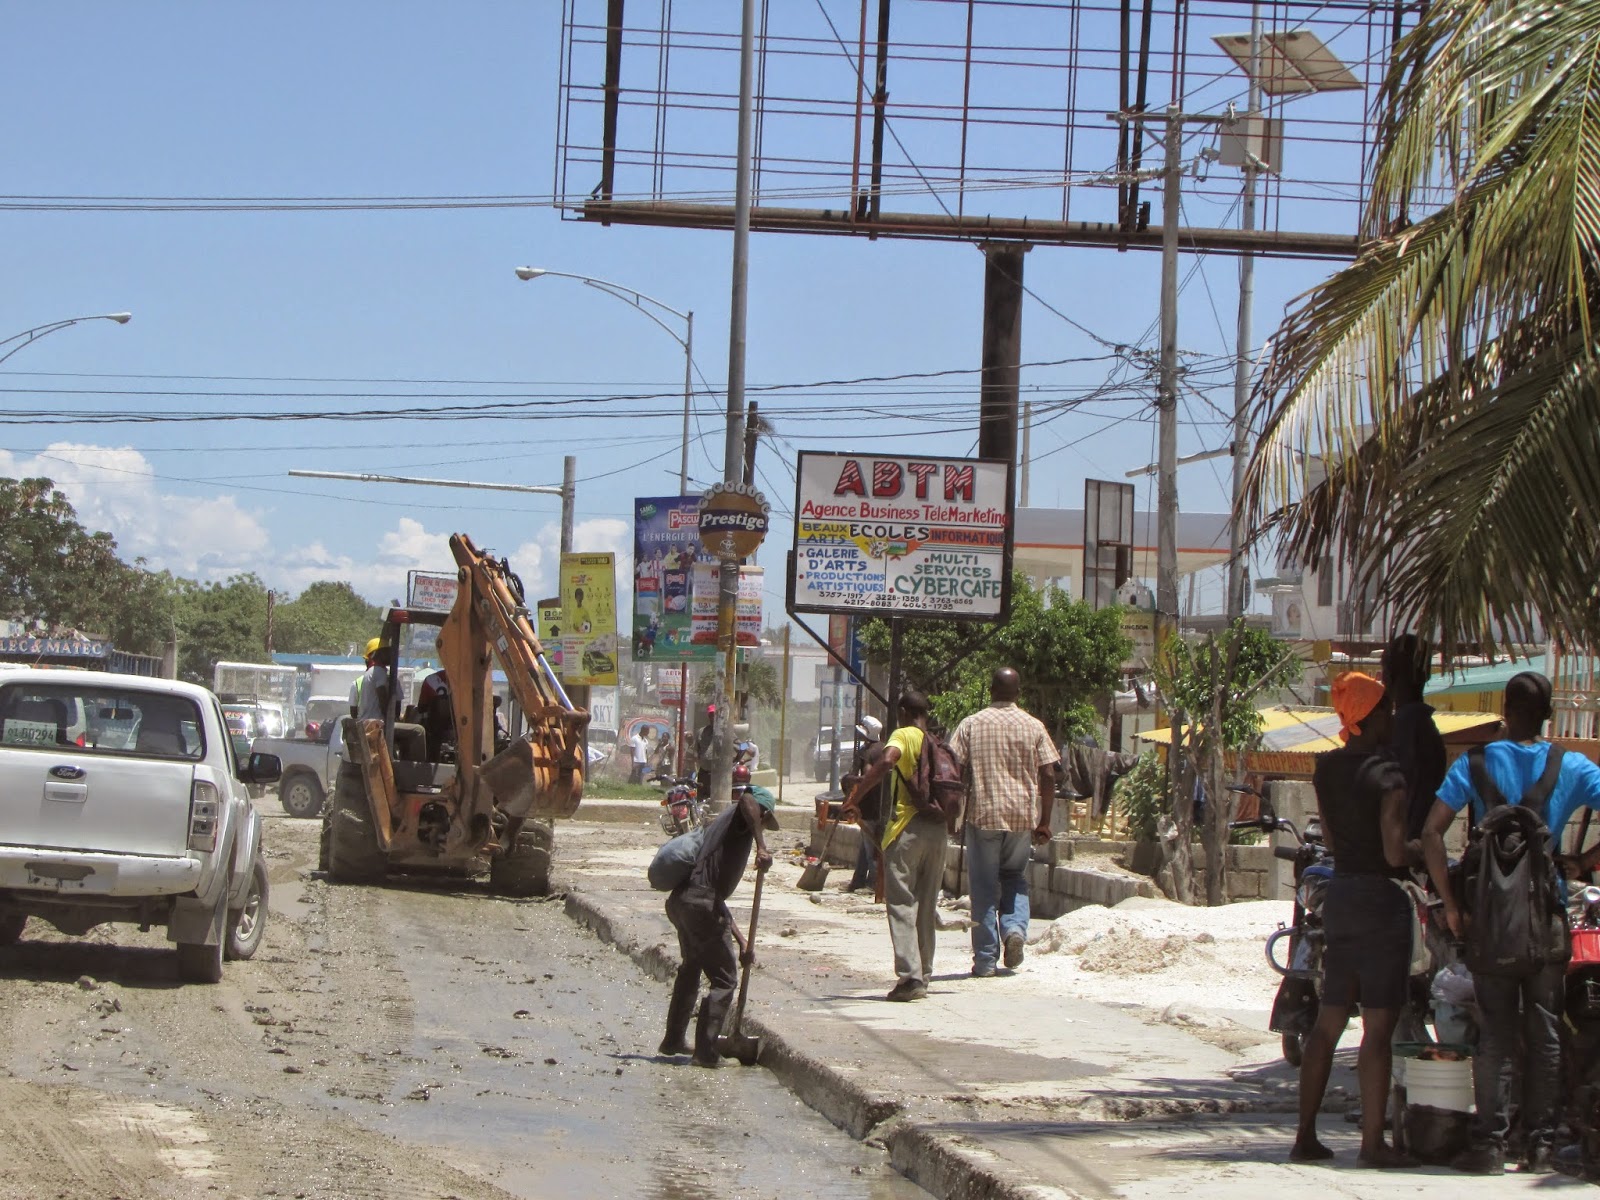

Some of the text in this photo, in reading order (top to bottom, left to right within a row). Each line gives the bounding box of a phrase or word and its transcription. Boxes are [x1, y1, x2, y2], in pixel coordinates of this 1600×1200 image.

[833, 460, 974, 501] ABTM
[802, 500, 857, 520] Agence
[860, 502, 920, 520] Business
[700, 513, 765, 530] Prestige
[802, 523, 848, 533] BEAUX
[849, 524, 930, 541] ECOLES
[688, 532, 699, 541] DU
[806, 533, 846, 545] ARTS
[806, 548, 859, 559] GALERIE
[930, 553, 979, 565] MULTI
[808, 559, 867, 571] D'ARTS
[913, 564, 992, 578] SERVICES
[806, 571, 885, 581] PRODUCTIONS
[807, 581, 884, 593] ARTISTIQUES
[0, 639, 27, 652] LEC
[47, 641, 102, 655] MATEC
[593, 704, 613, 722] SKY
[57, 767, 78, 777] Ford
